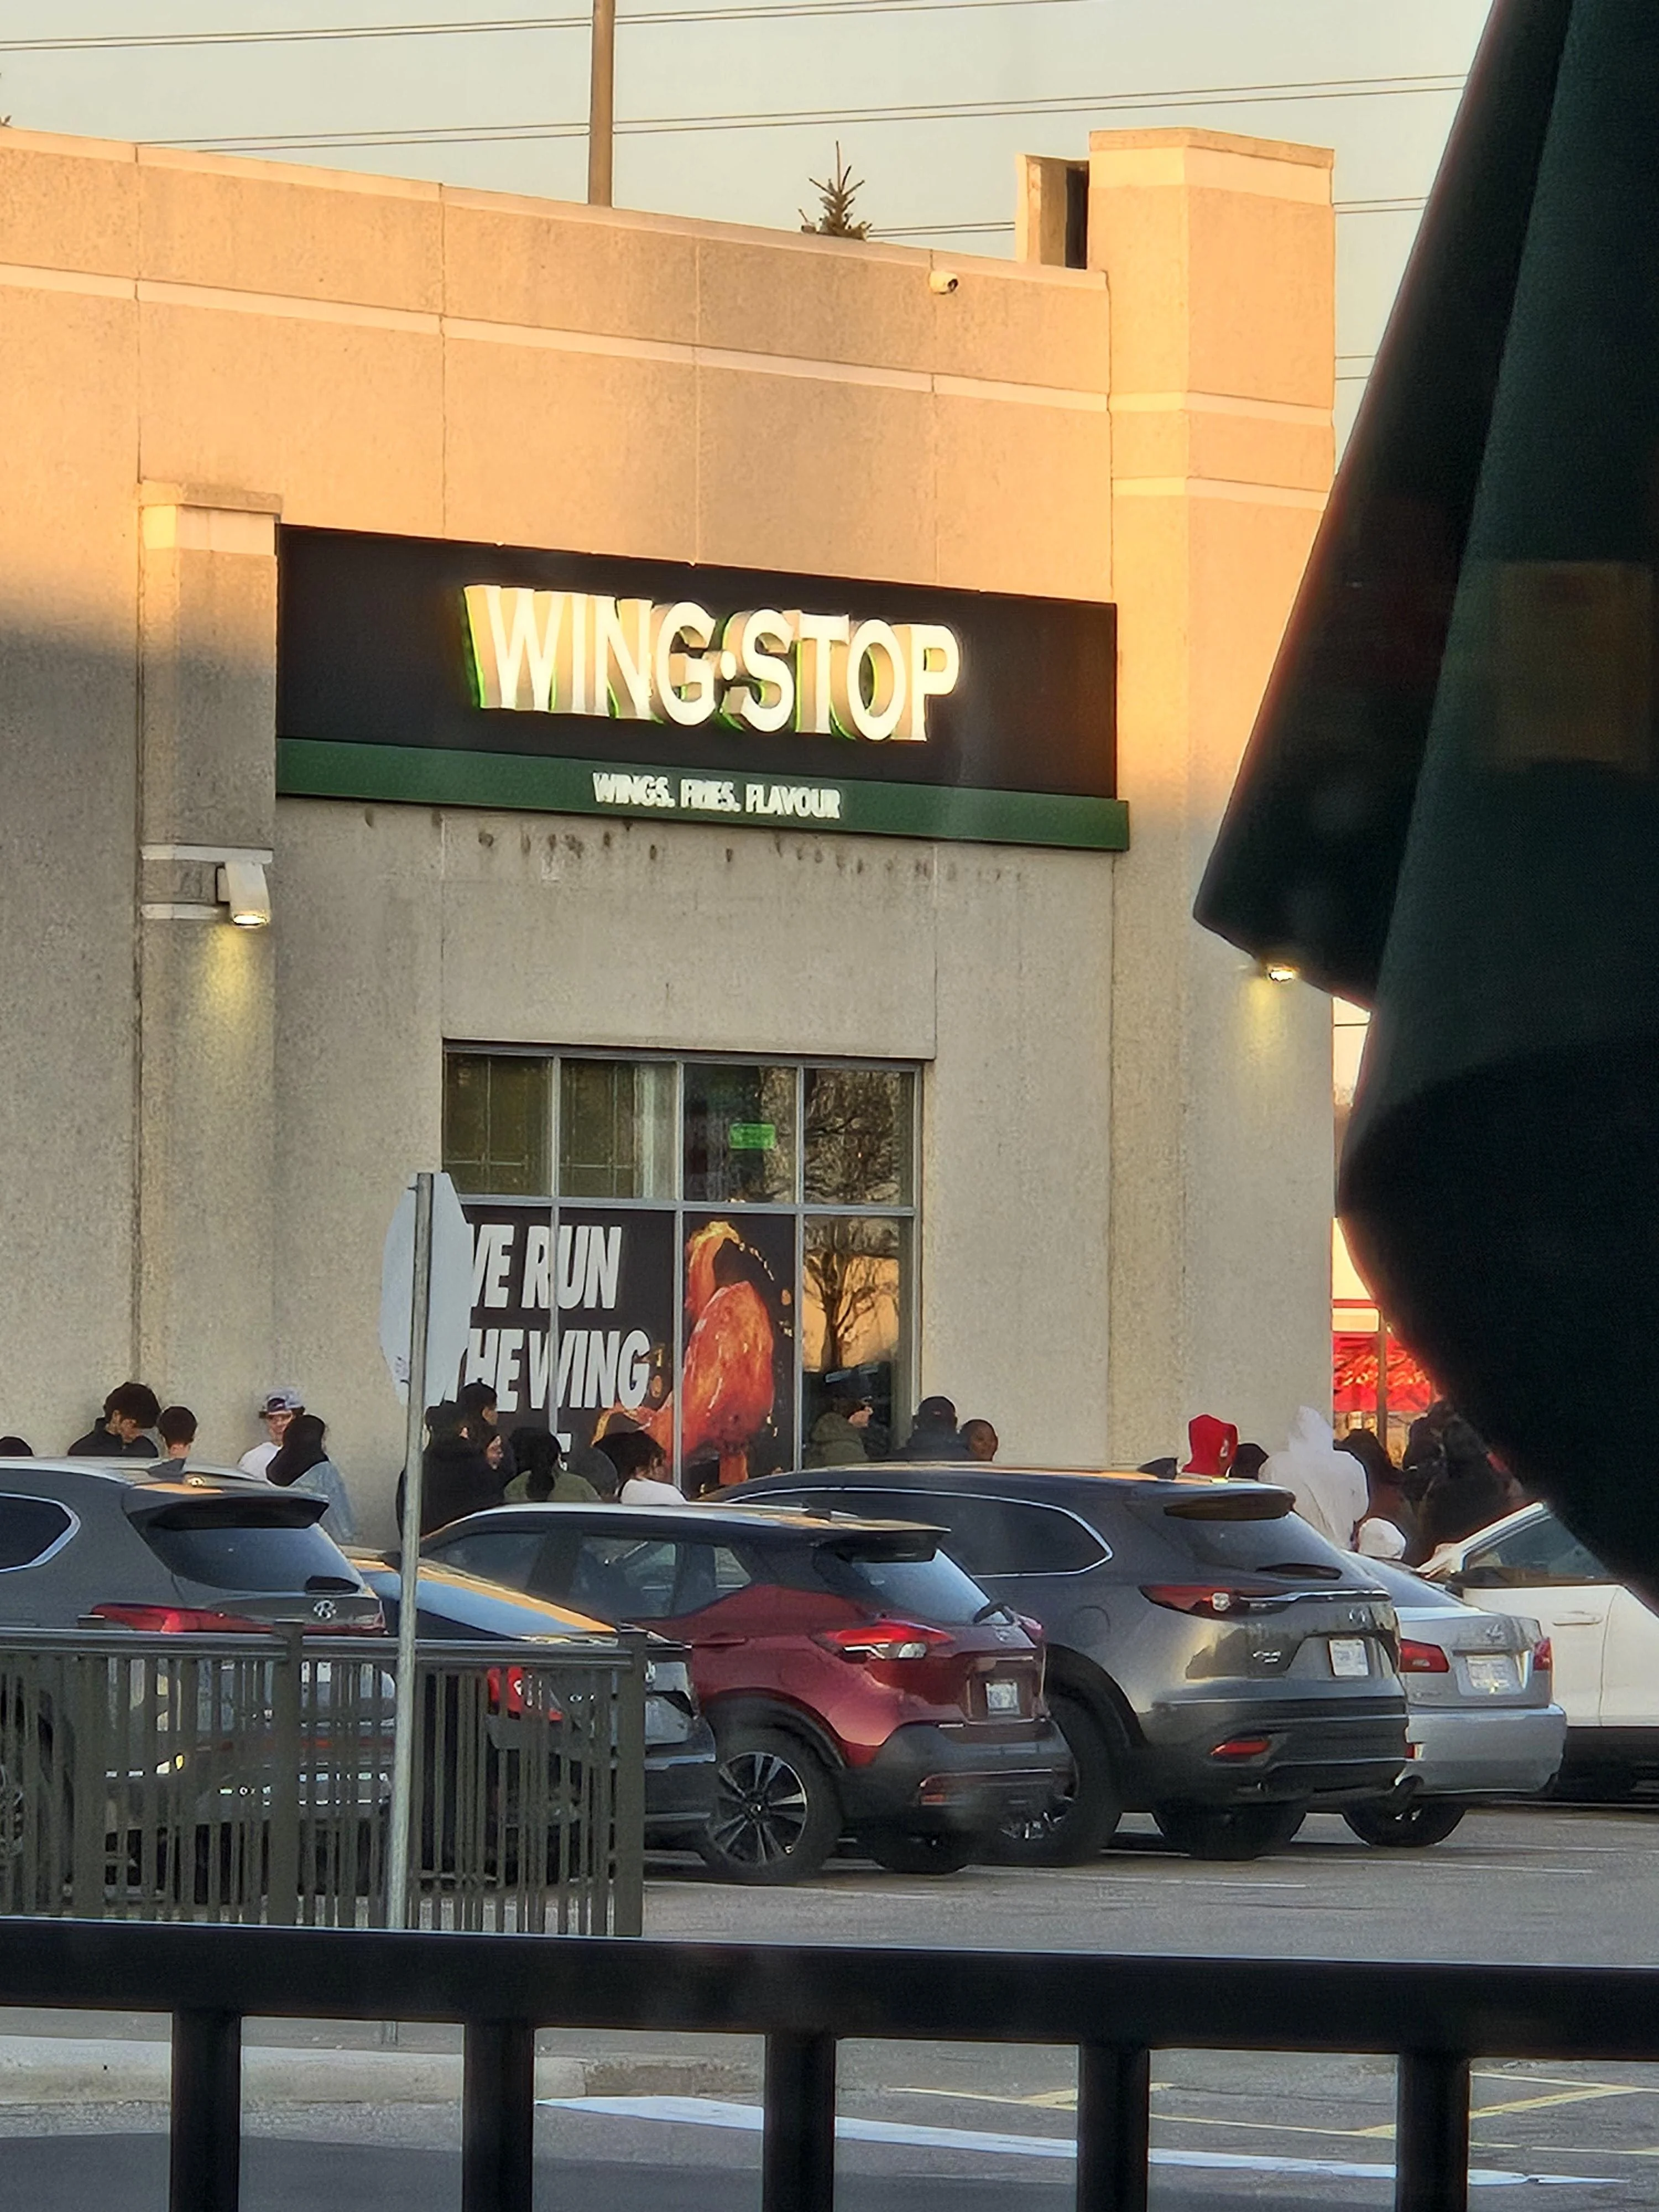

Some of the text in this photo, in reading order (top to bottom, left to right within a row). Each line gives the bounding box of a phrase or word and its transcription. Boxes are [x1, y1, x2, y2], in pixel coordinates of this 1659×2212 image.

[592, 772, 675, 808] WINGS.
[745, 783, 841, 819] FLAVOUR
[521, 1225, 622, 1309] RUN
[529, 1329, 650, 1410] WING
